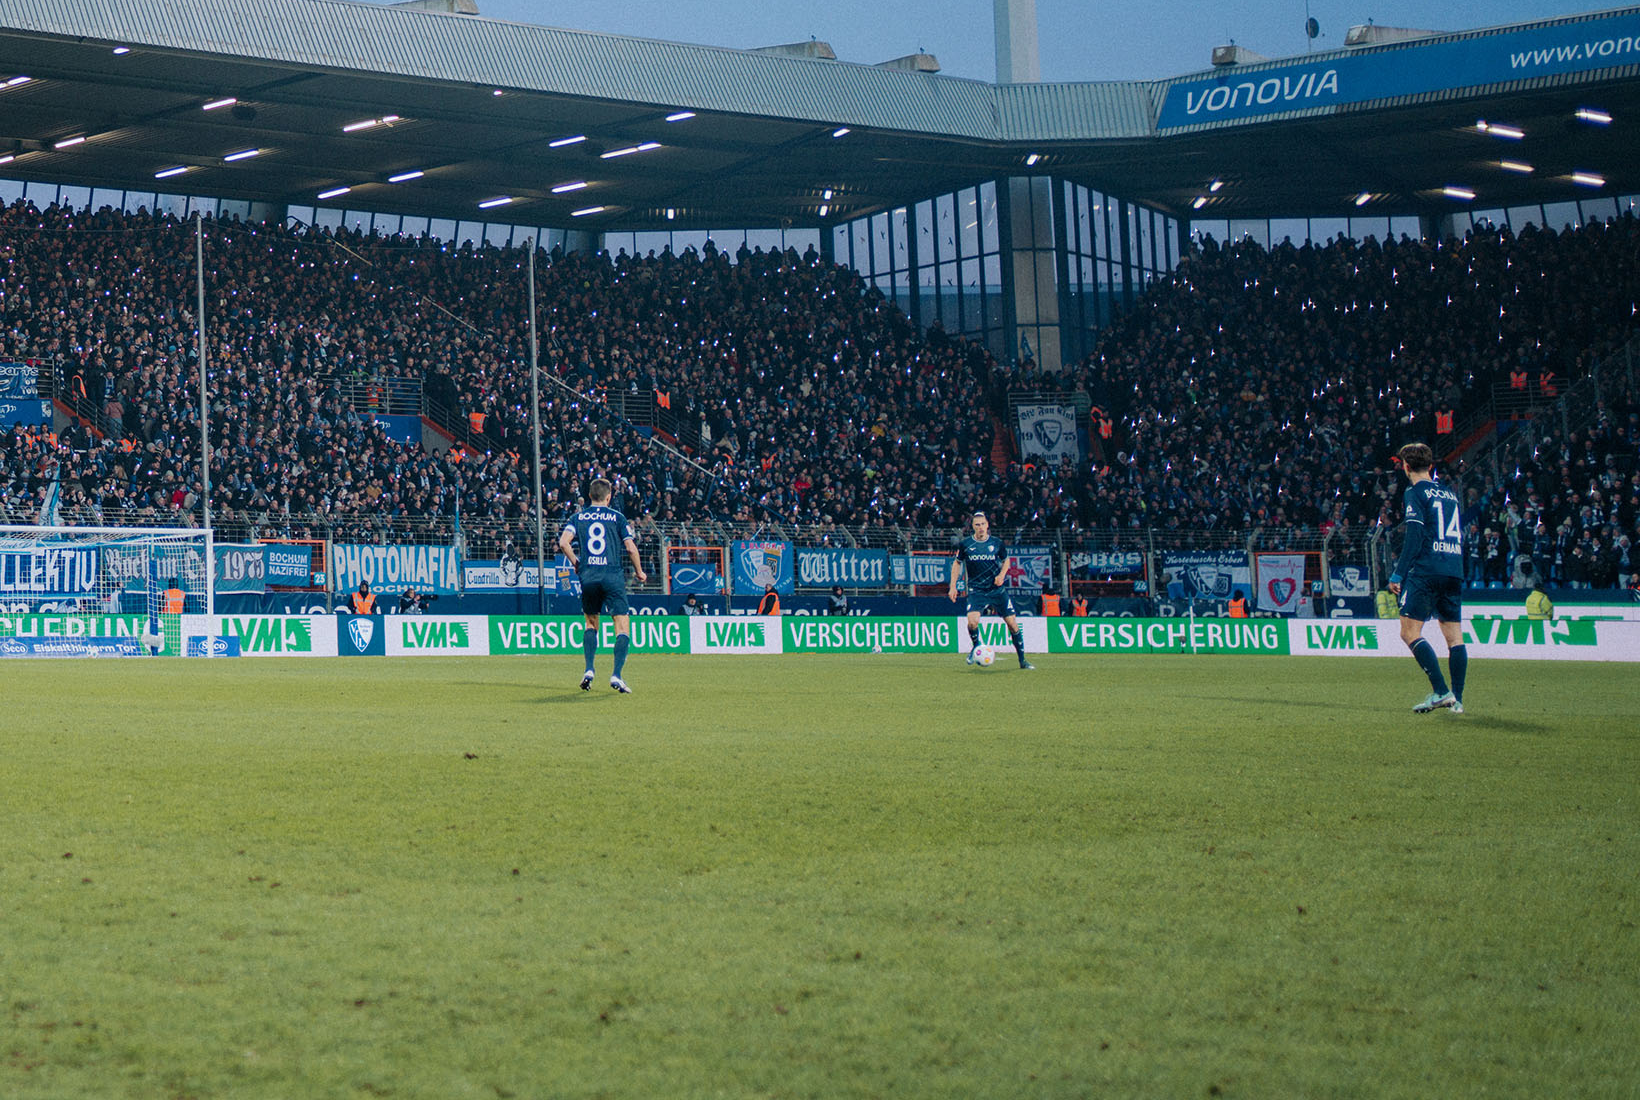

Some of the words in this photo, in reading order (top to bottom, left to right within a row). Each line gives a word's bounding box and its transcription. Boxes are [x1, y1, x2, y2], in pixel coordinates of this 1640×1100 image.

[578, 512, 617, 522] BOCHUM
[1432, 500, 1462, 544] 14
[587, 521, 606, 556] 8
[222, 550, 266, 581] 1975
[269, 551, 308, 564] BOCHUM
[334, 545, 459, 592] PHOTOMAFIA
[799, 552, 884, 583] Witten
[909, 557, 945, 583] Kult
[1218, 554, 1244, 564] Erben
[268, 564, 308, 577] NAZIFREI
[314, 573, 326, 584] 23
[524, 569, 555, 586] Bocum
[715, 576, 724, 588] 24
[956, 581, 966, 590] 25
[1136, 581, 1147, 590] 26
[1312, 582, 1323, 591] 27
[201, 642, 226, 650] Sco
[221, 617, 281, 652] LVM
[402, 621, 447, 648] LVM
[498, 621, 681, 648] VERSICEUNG
[705, 622, 747, 647] LVM
[791, 622, 950, 647] VERSICHERUNG
[1059, 623, 1279, 648] VERSICHERUNG
[1306, 625, 1356, 650] LVM
[3, 644, 26, 653] Seco
[116, 643, 137, 652] Tor
